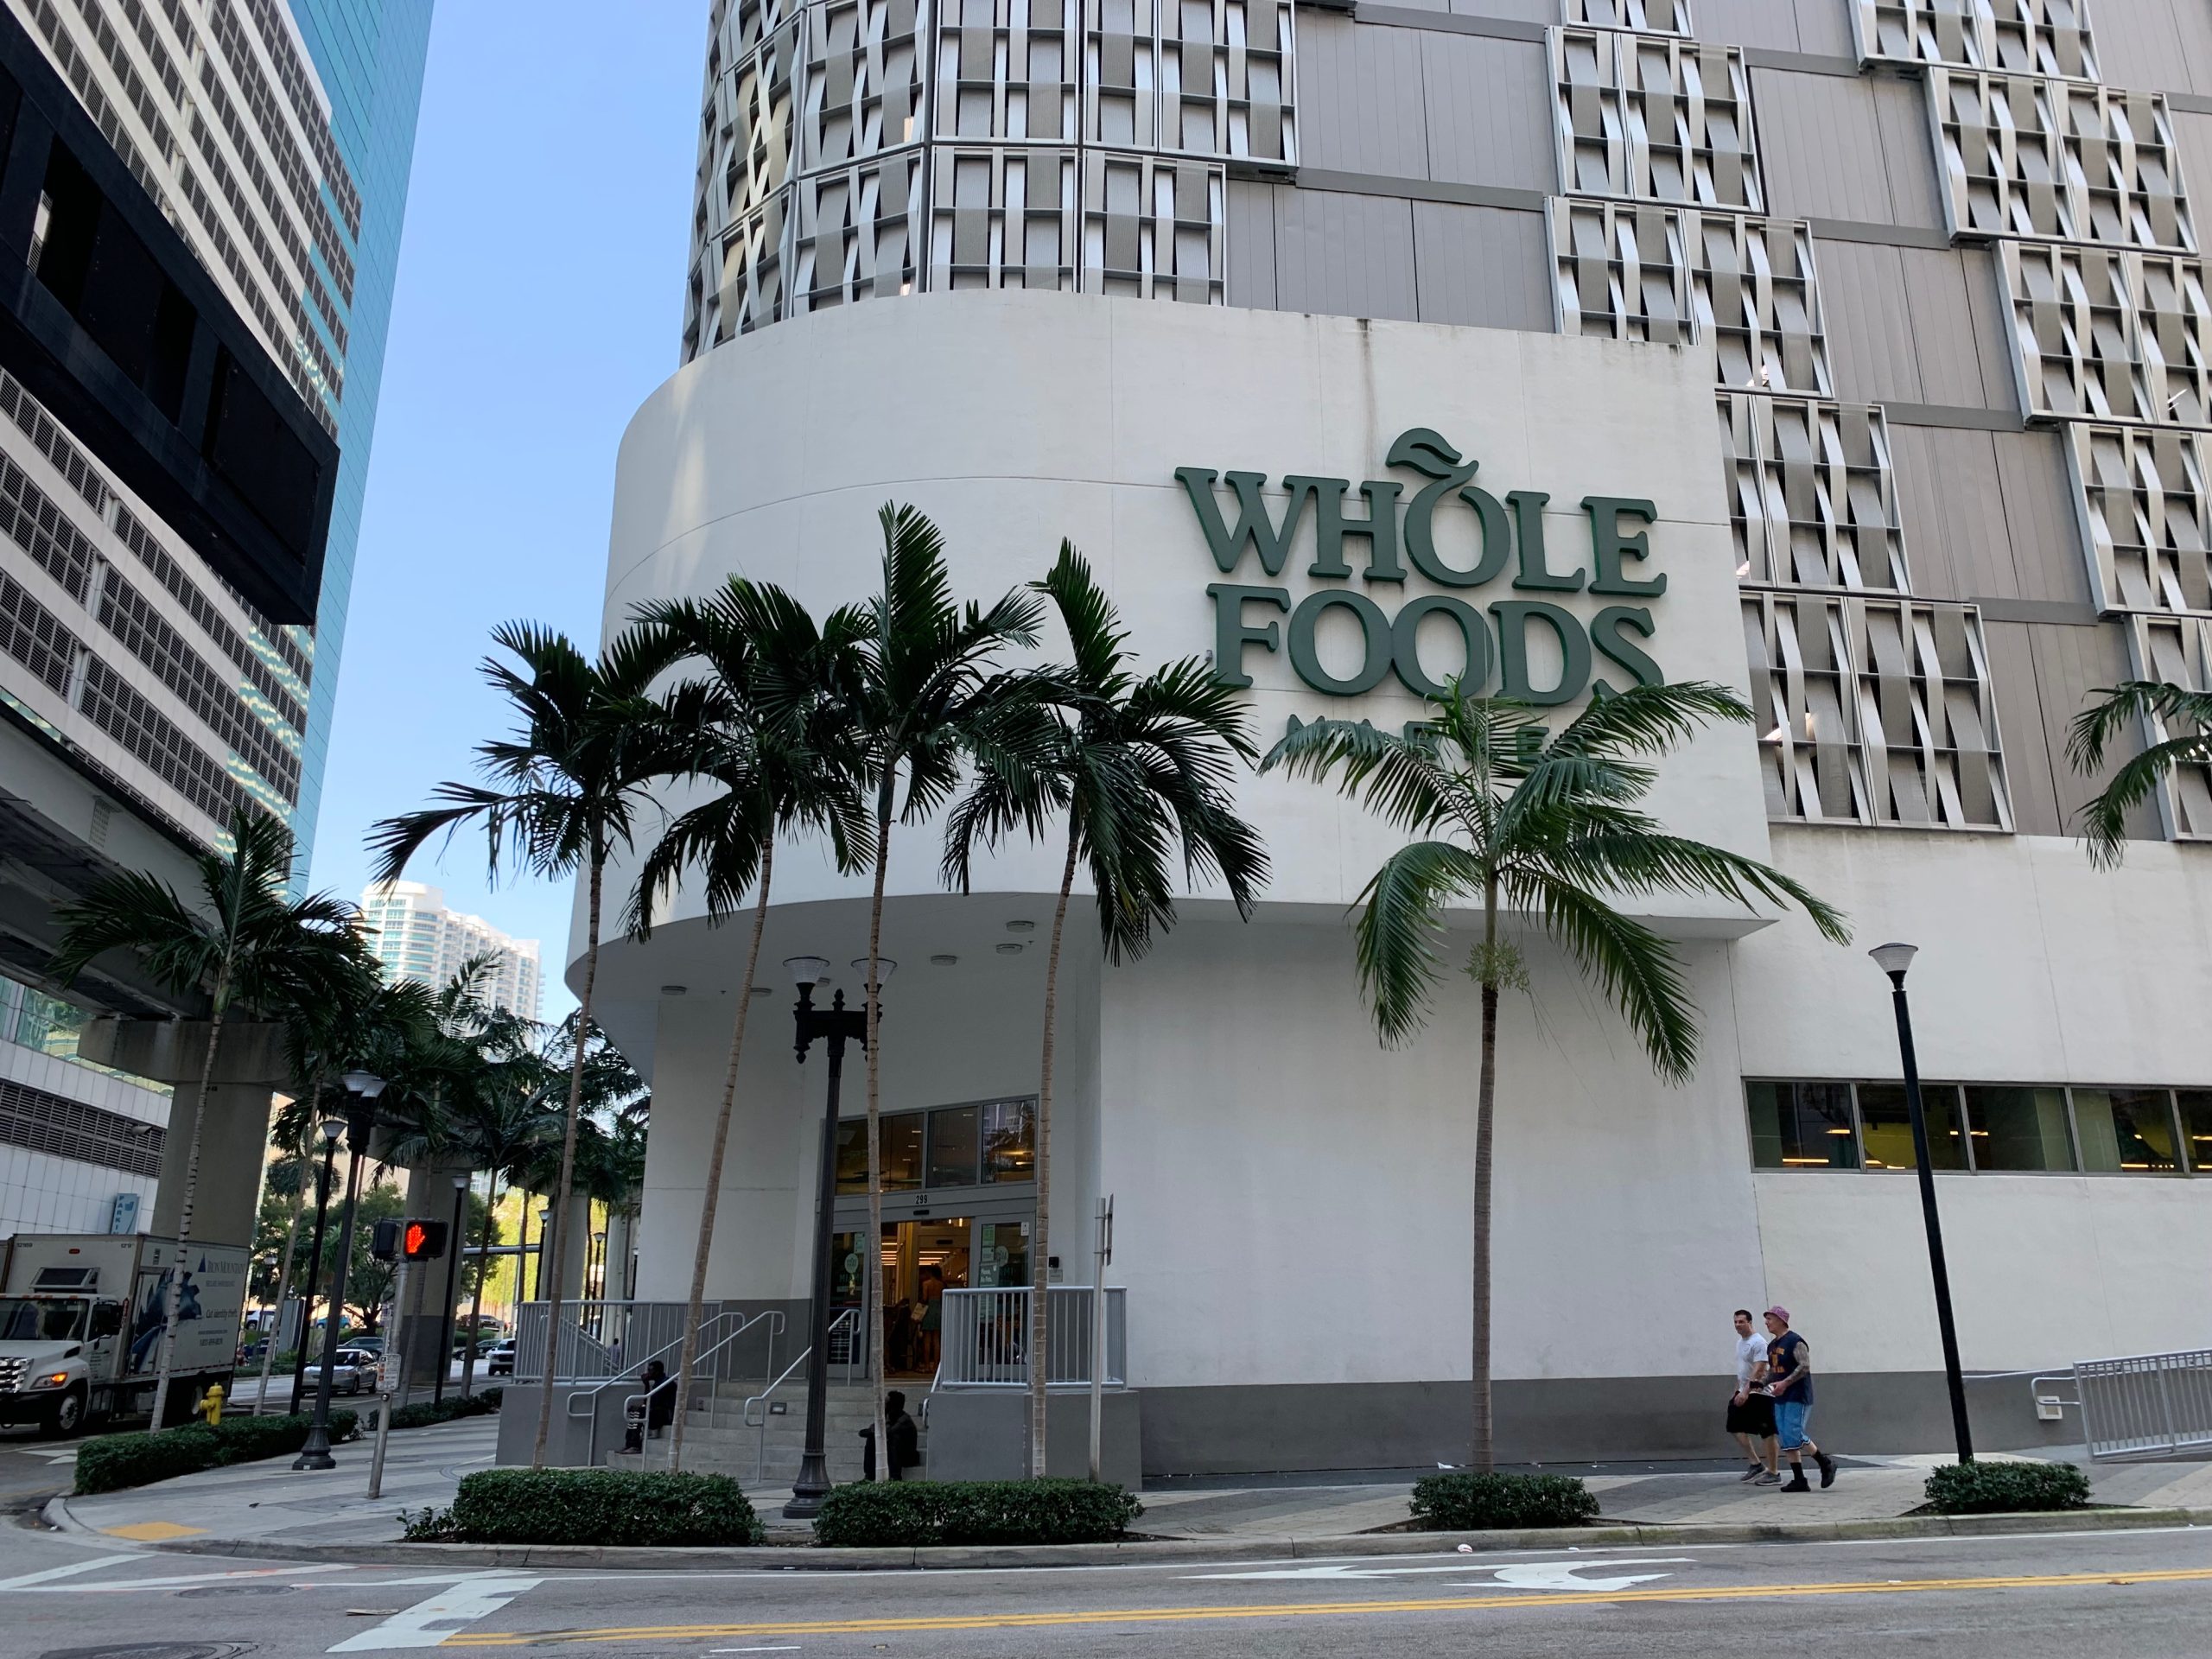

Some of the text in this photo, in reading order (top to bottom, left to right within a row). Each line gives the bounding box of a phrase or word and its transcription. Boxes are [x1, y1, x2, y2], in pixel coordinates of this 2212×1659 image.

[1173, 427, 1668, 598] WHOLE
[1205, 582, 1665, 707] FOODS
[915, 1194, 928, 1205] 299
